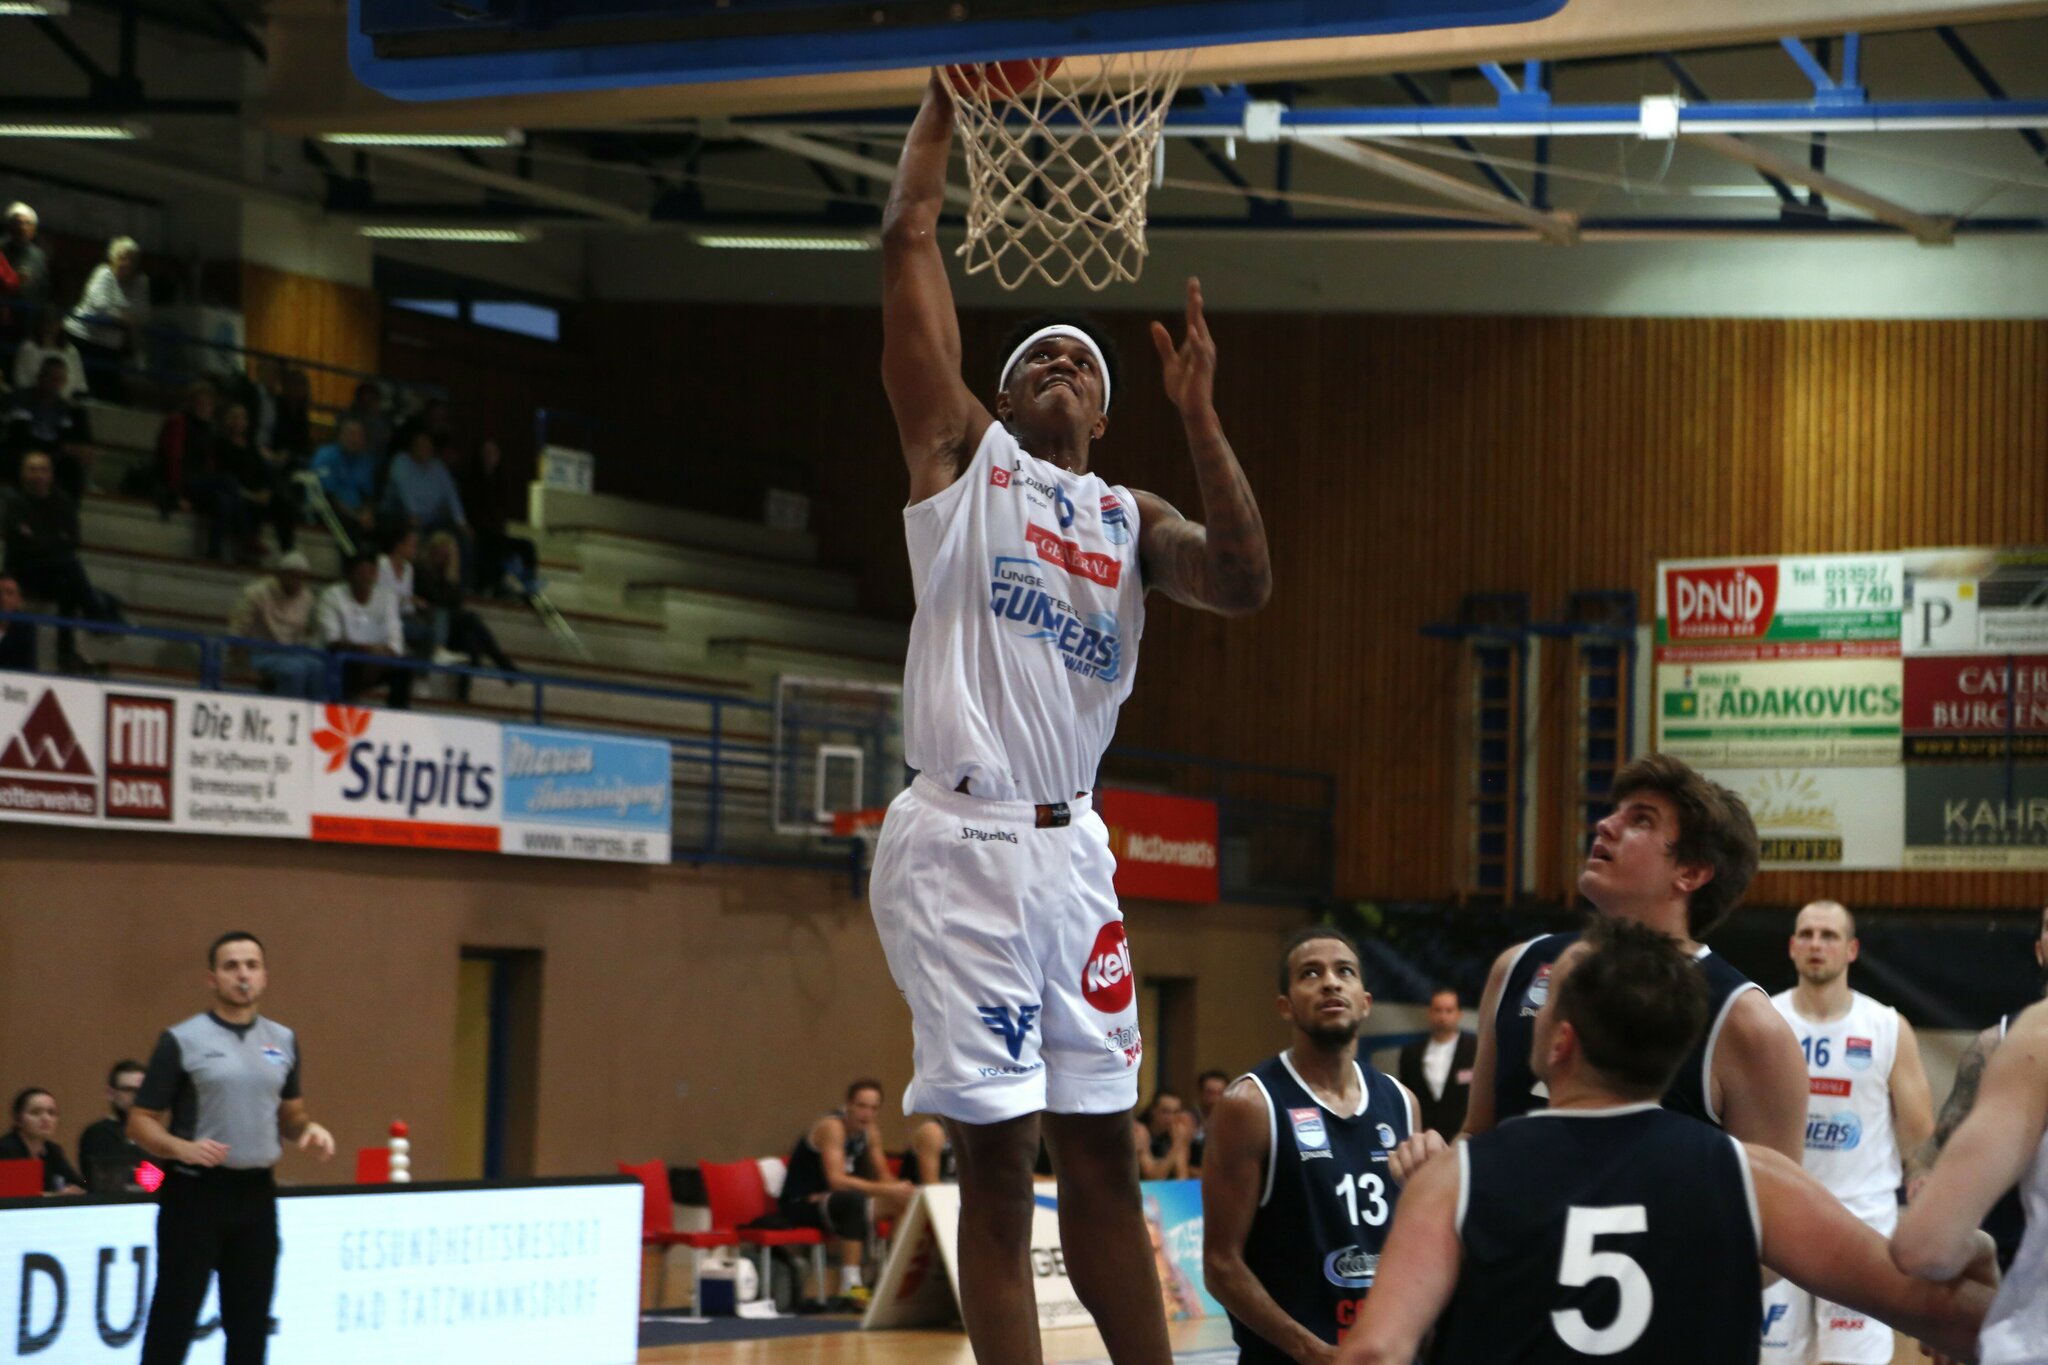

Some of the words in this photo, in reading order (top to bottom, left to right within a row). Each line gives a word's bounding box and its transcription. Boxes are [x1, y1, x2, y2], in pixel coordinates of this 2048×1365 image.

[1001, 569, 1046, 588] UNGE
[1923, 598, 1952, 646] P
[191, 702, 232, 741] Die
[241, 706, 274, 744] Nr.
[286, 711, 299, 746] 1
[110, 779, 166, 809] DATA
[342, 740, 496, 817] Stipits
[961, 826, 1018, 845] SPALDING
[1801, 1035, 1831, 1068] 16
[1336, 1172, 1389, 1227] 13
[1551, 1205, 1653, 1355] 5
[336, 1289, 384, 1333] BAD
